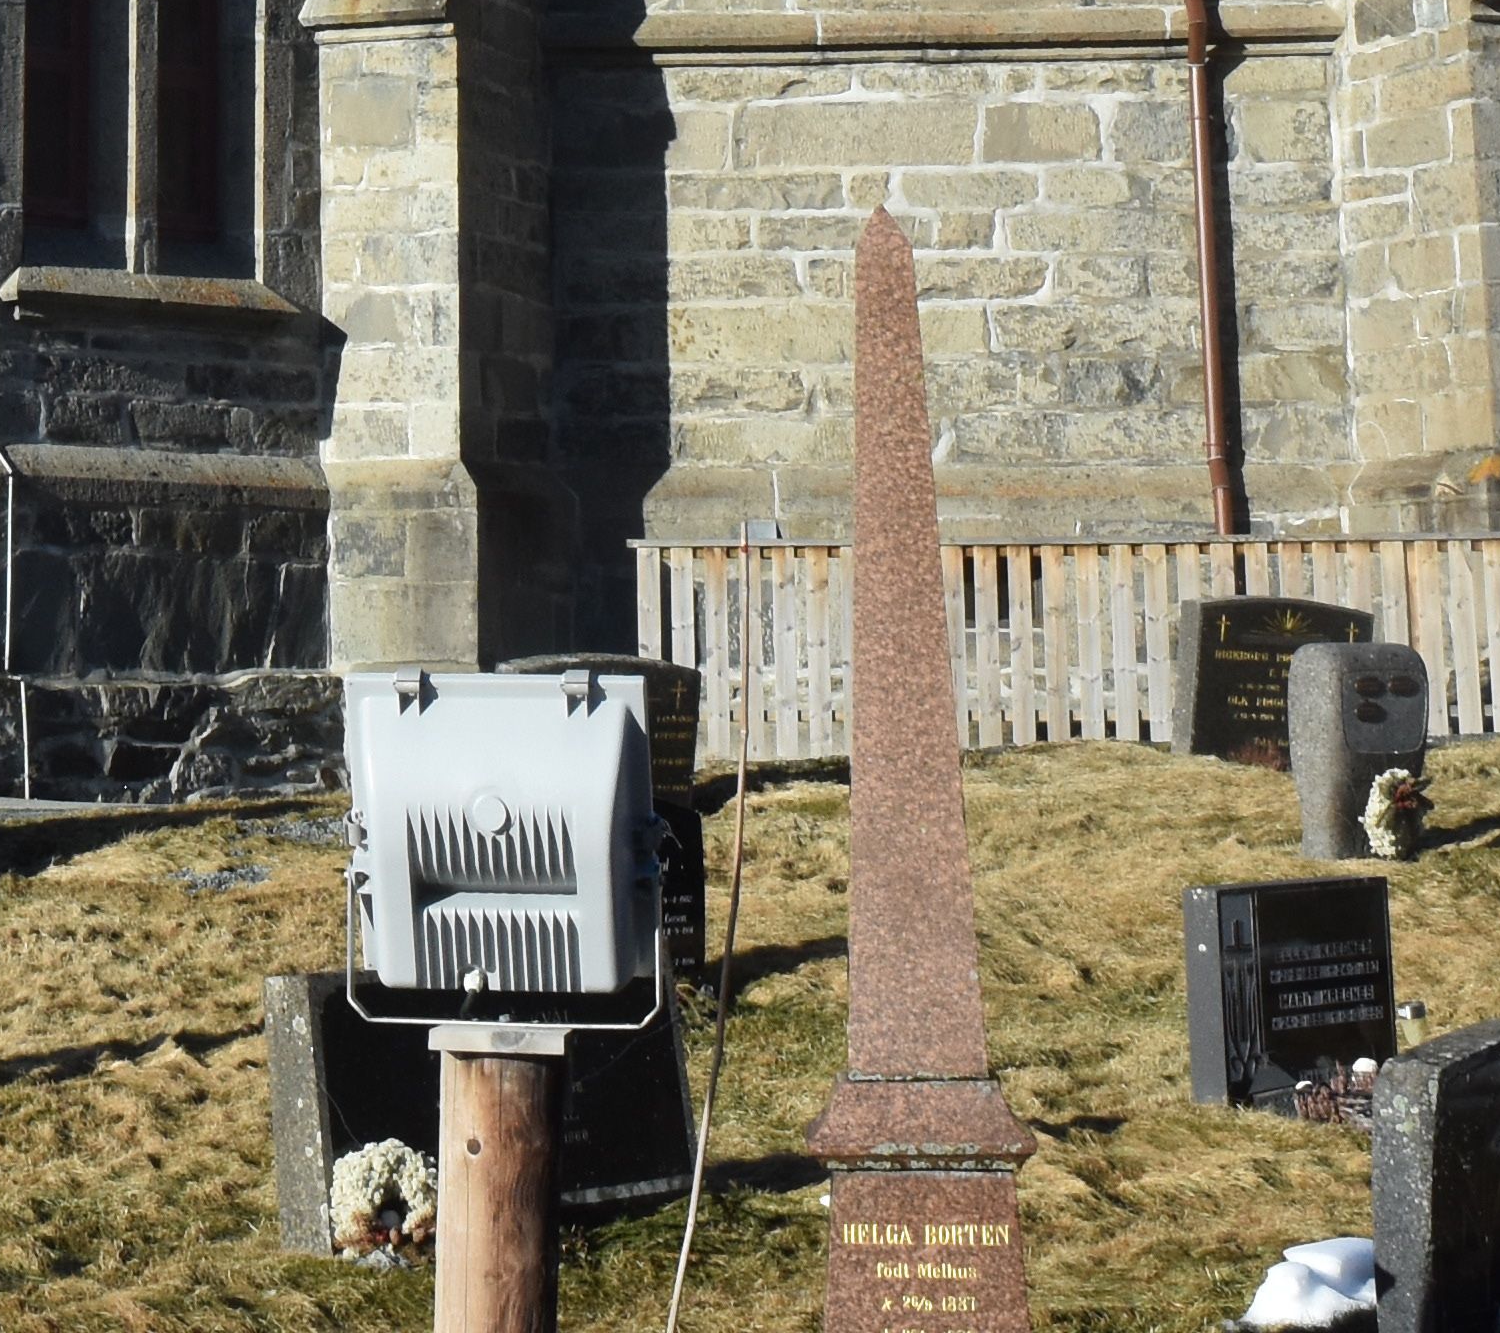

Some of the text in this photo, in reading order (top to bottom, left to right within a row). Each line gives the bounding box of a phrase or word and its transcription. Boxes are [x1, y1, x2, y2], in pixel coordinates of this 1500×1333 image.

[843, 1222, 1010, 1247] HELGA BORTEN
[917, 1262, 977, 1279] Melhus
